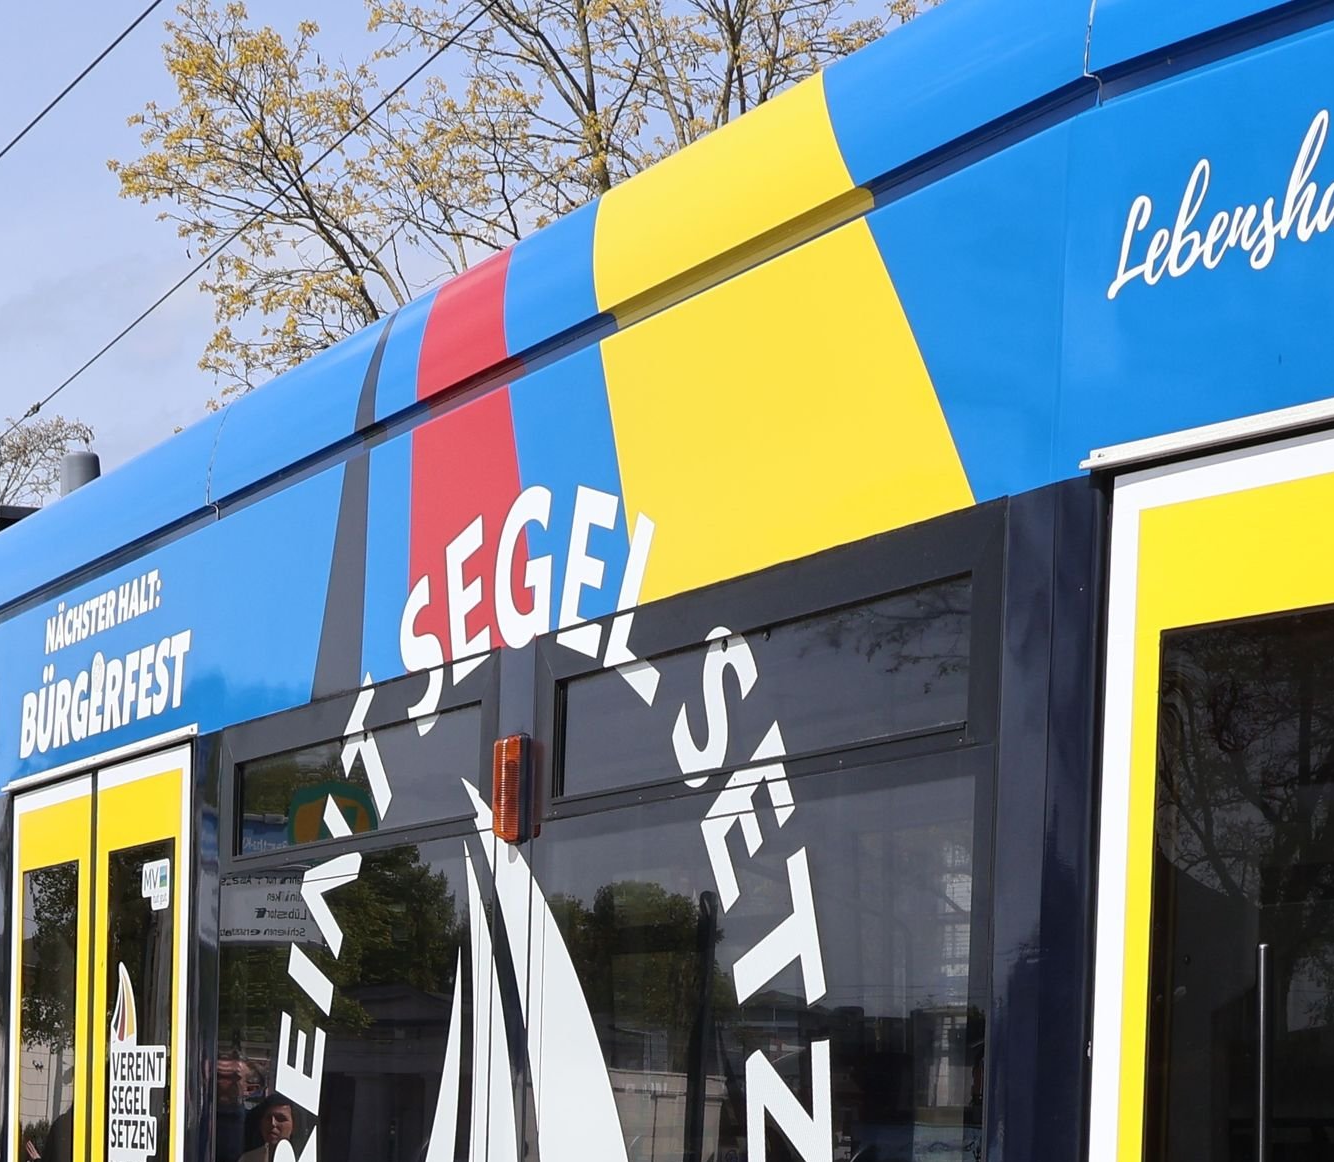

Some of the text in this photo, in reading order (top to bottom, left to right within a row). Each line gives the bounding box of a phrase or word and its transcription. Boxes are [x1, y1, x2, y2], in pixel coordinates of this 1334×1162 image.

[44, 567, 163, 655] NÄCHSTER HALT:
[398, 484, 662, 737] SEGEL
[19, 628, 193, 760] BÜRGERFEST
[112, 1051, 164, 1082] VEREINT
[111, 1085, 147, 1116] SEGEL
[110, 1118, 155, 1150] SETZEN
